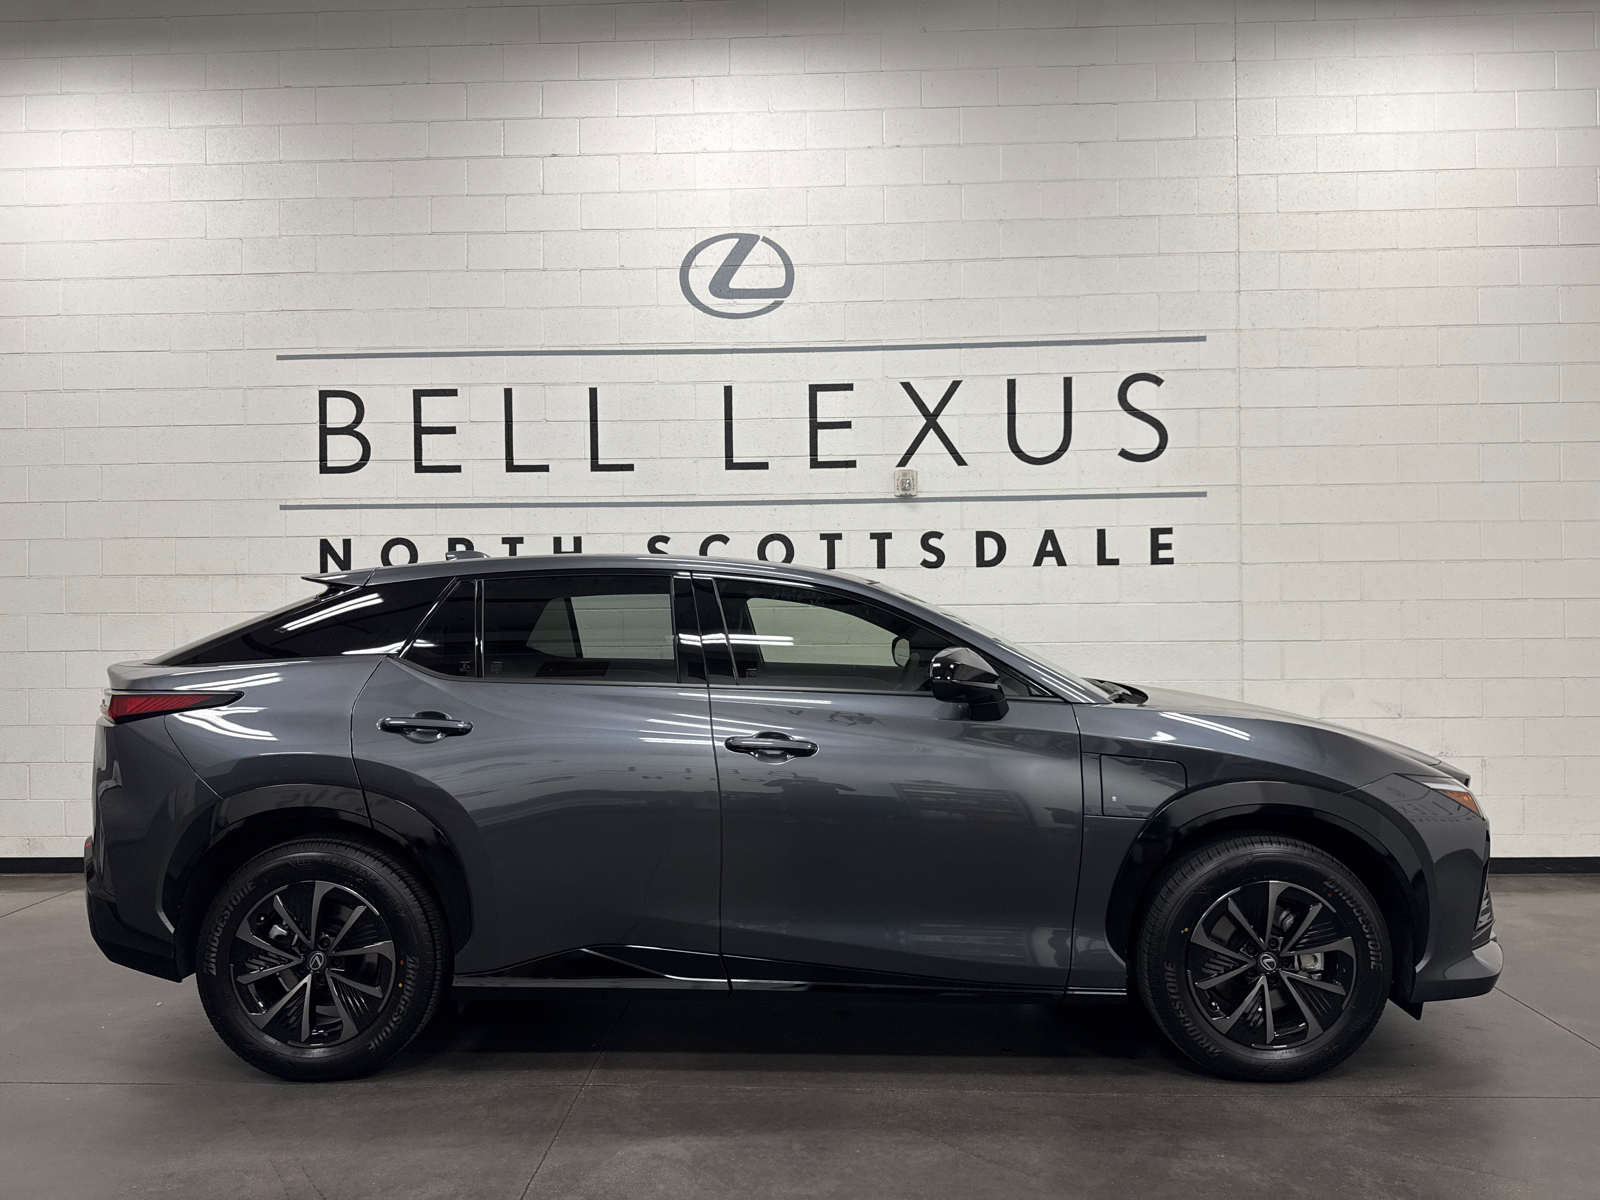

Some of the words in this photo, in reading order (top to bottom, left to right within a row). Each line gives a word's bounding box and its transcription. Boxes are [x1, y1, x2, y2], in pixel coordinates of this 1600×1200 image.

[319, 387, 635, 474] BELL
[724, 372, 1169, 471] LEXUS
[647, 527, 1175, 570] SCOTTSDALE
[203, 881, 257, 977] BRIDGESTONE
[1322, 874, 1383, 972] BRIDGESTONE
[368, 955, 420, 1054] BRIDGESTONE
